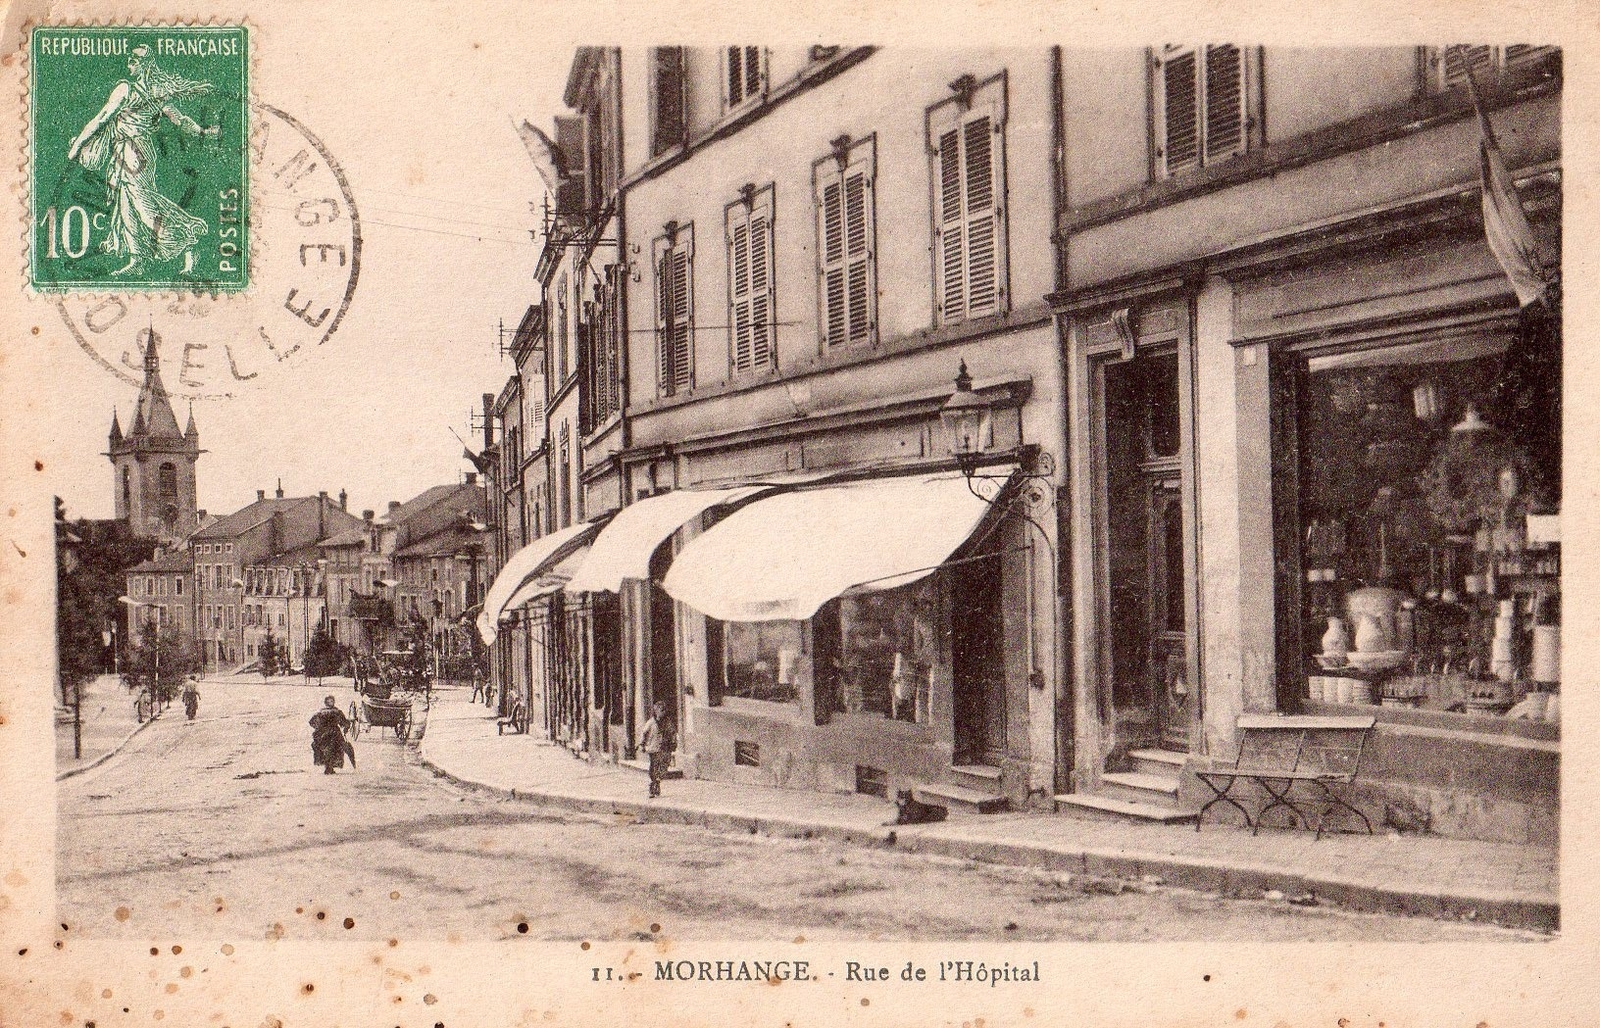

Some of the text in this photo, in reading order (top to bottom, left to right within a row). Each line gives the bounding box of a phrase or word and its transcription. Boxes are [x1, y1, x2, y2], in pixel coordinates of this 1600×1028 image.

[41, 37, 239, 57] REPUBLIQUE FRANÇAISE
[219, 188, 239, 272] POSTES
